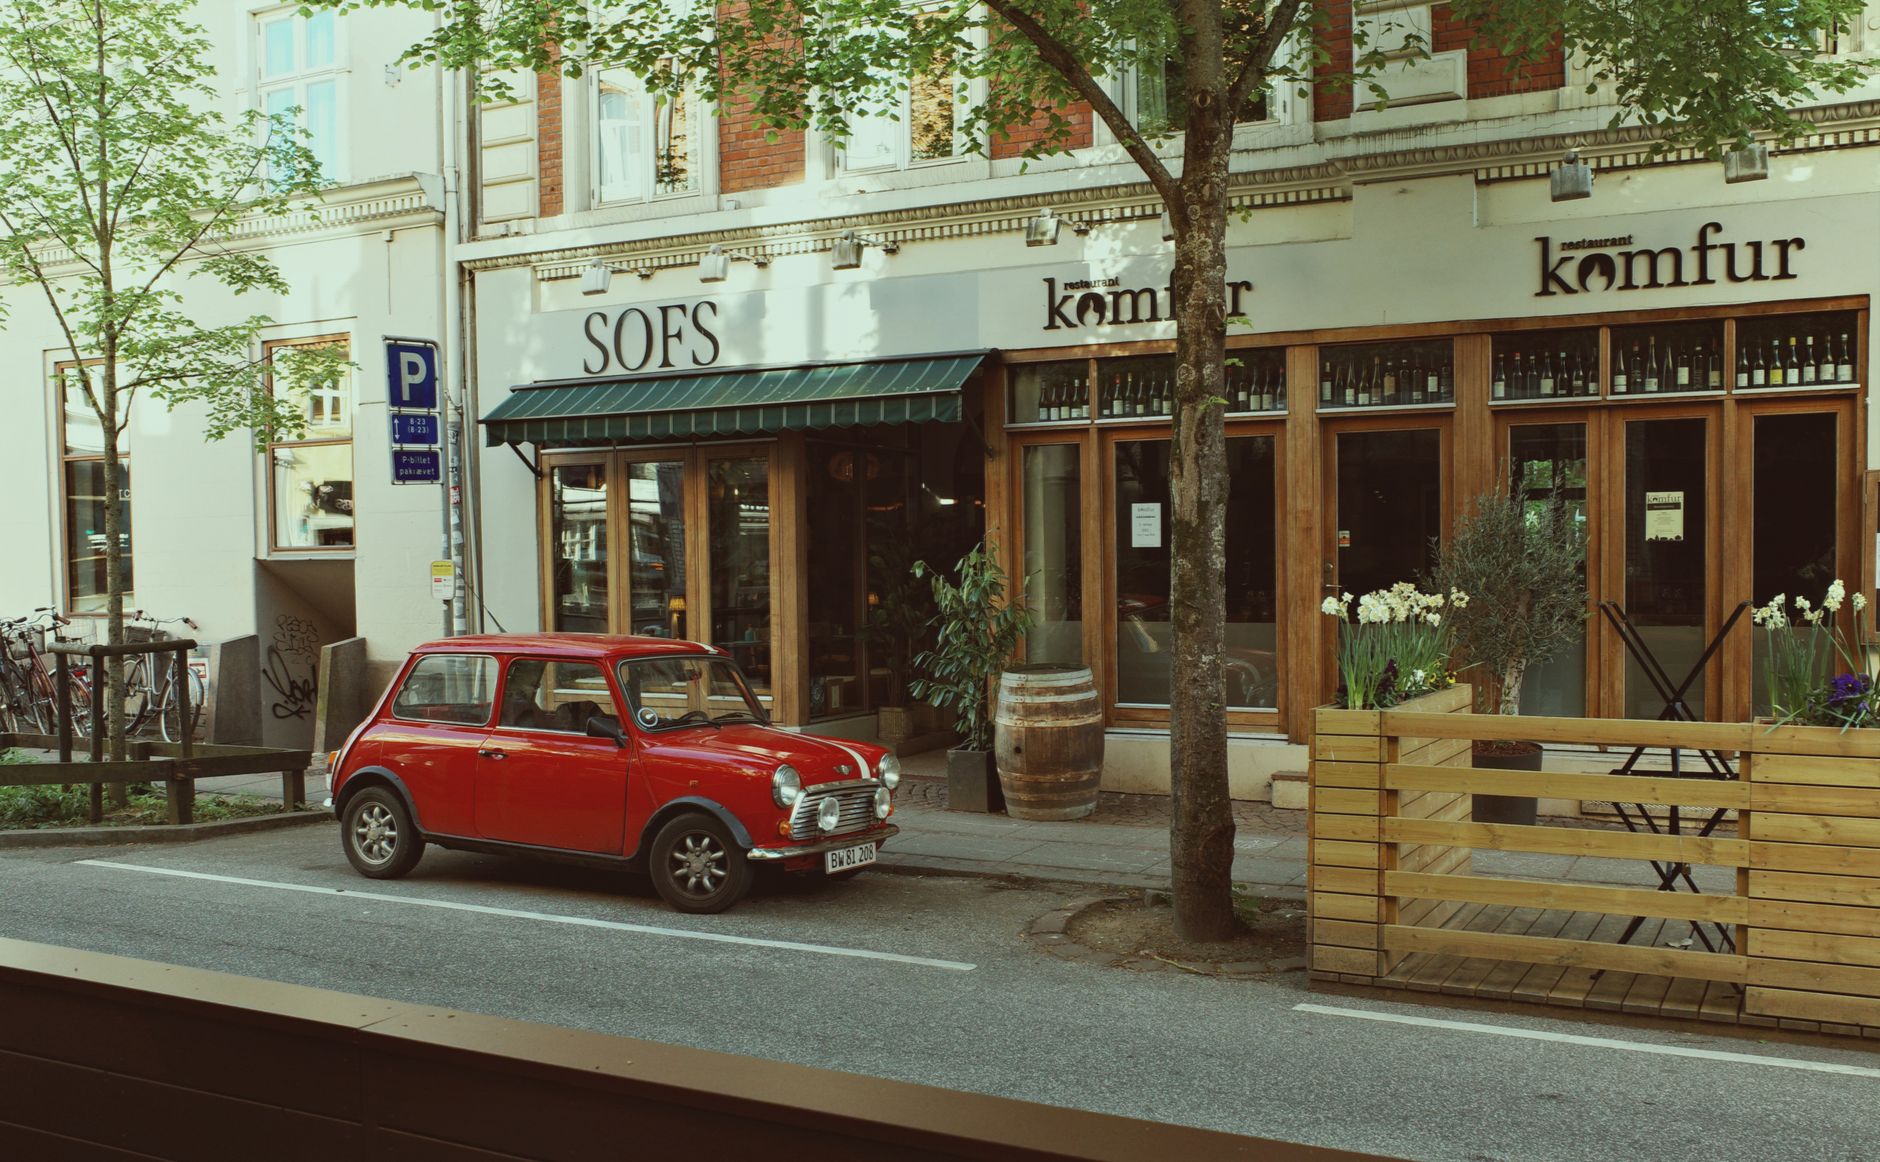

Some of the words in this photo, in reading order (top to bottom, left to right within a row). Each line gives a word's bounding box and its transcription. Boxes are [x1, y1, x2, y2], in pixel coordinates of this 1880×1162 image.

[1534, 221, 1806, 297] komfur
[1560, 233, 1634, 251] restaurant
[1042, 268, 1254, 331] komfr
[1063, 276, 1121, 291] restaurant
[583, 300, 720, 375] SOFS
[400, 351, 427, 401] P
